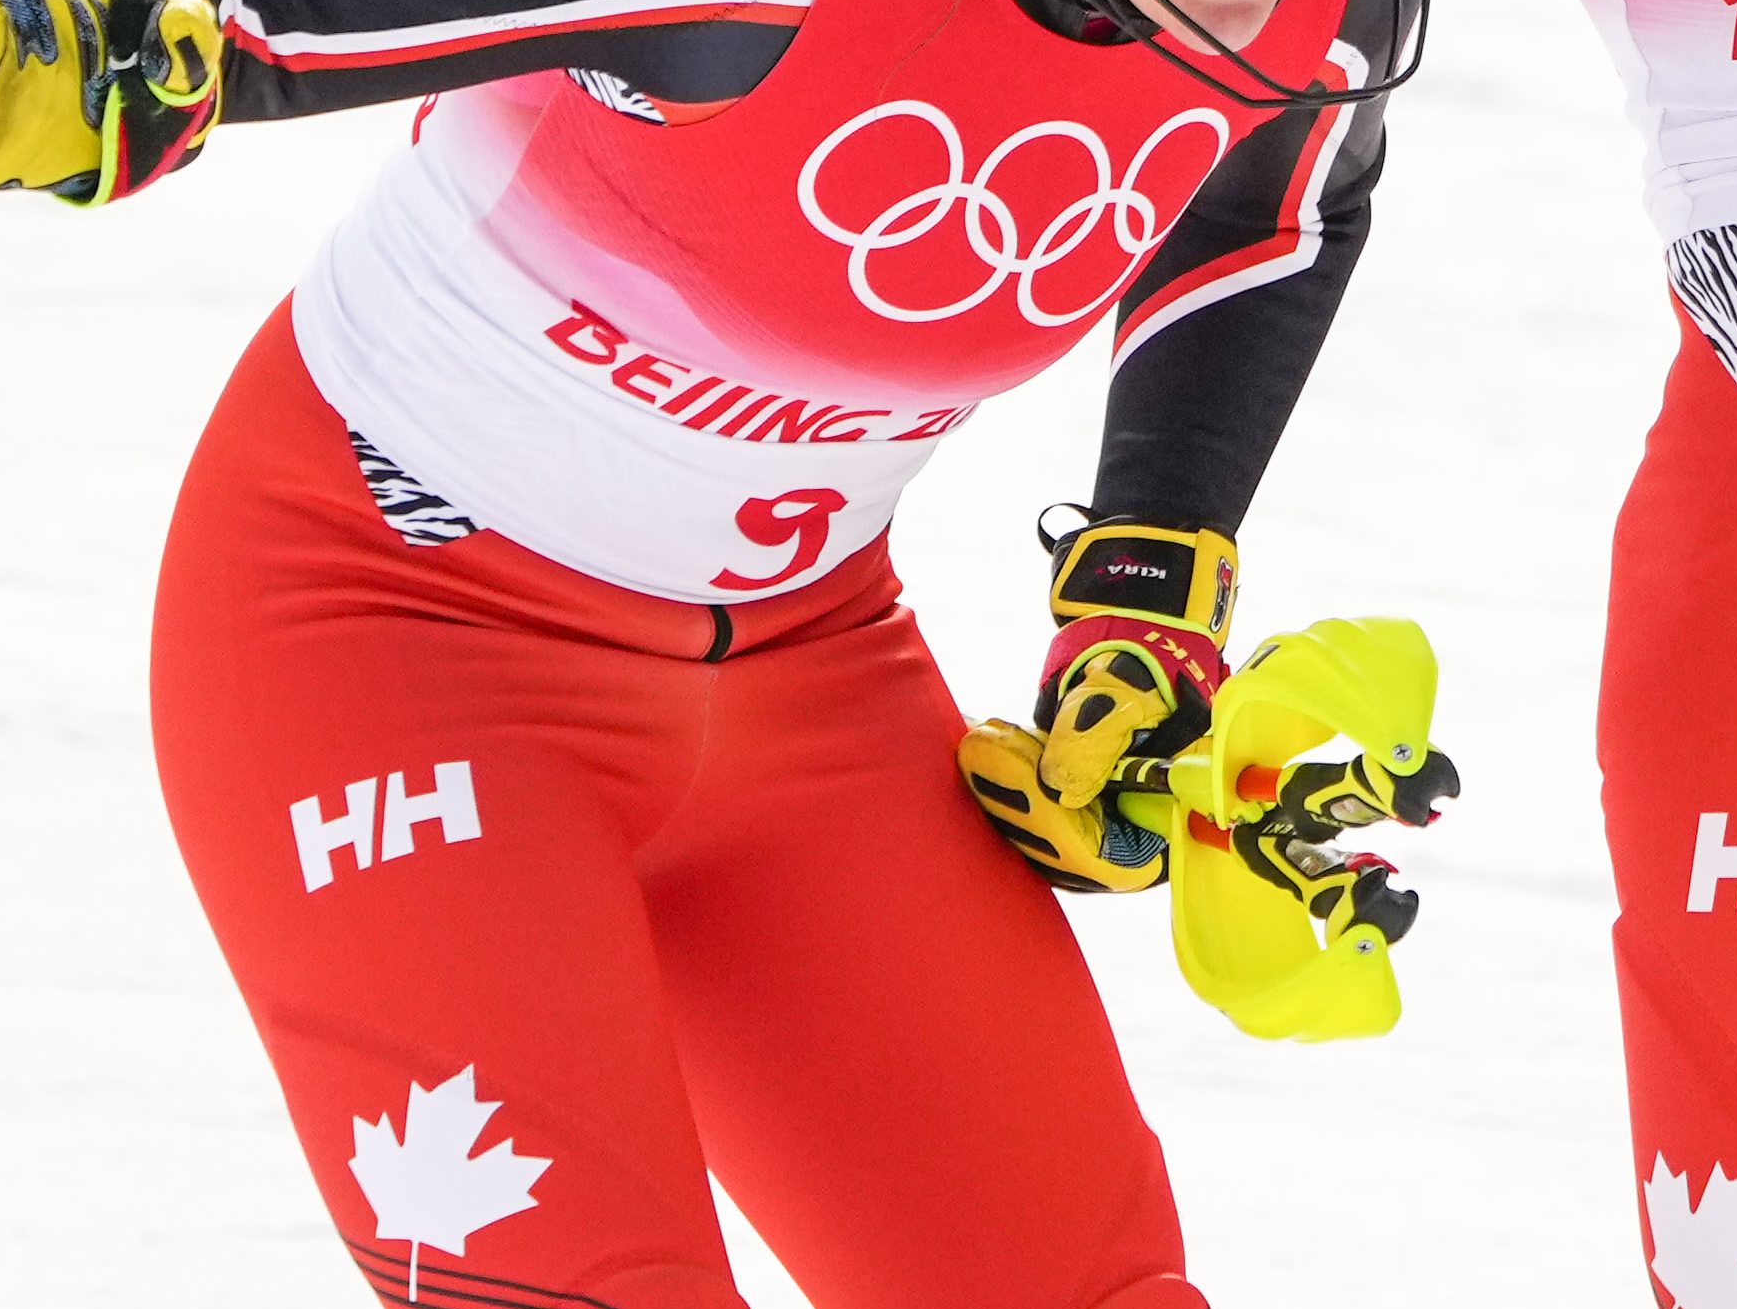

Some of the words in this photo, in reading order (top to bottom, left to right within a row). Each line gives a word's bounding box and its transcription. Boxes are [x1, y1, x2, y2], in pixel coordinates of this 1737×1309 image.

[544, 299, 893, 443] BEIJING
[709, 488, 849, 591] 9
[1106, 564, 1167, 580] KIRA
[289, 760, 482, 893] HH
